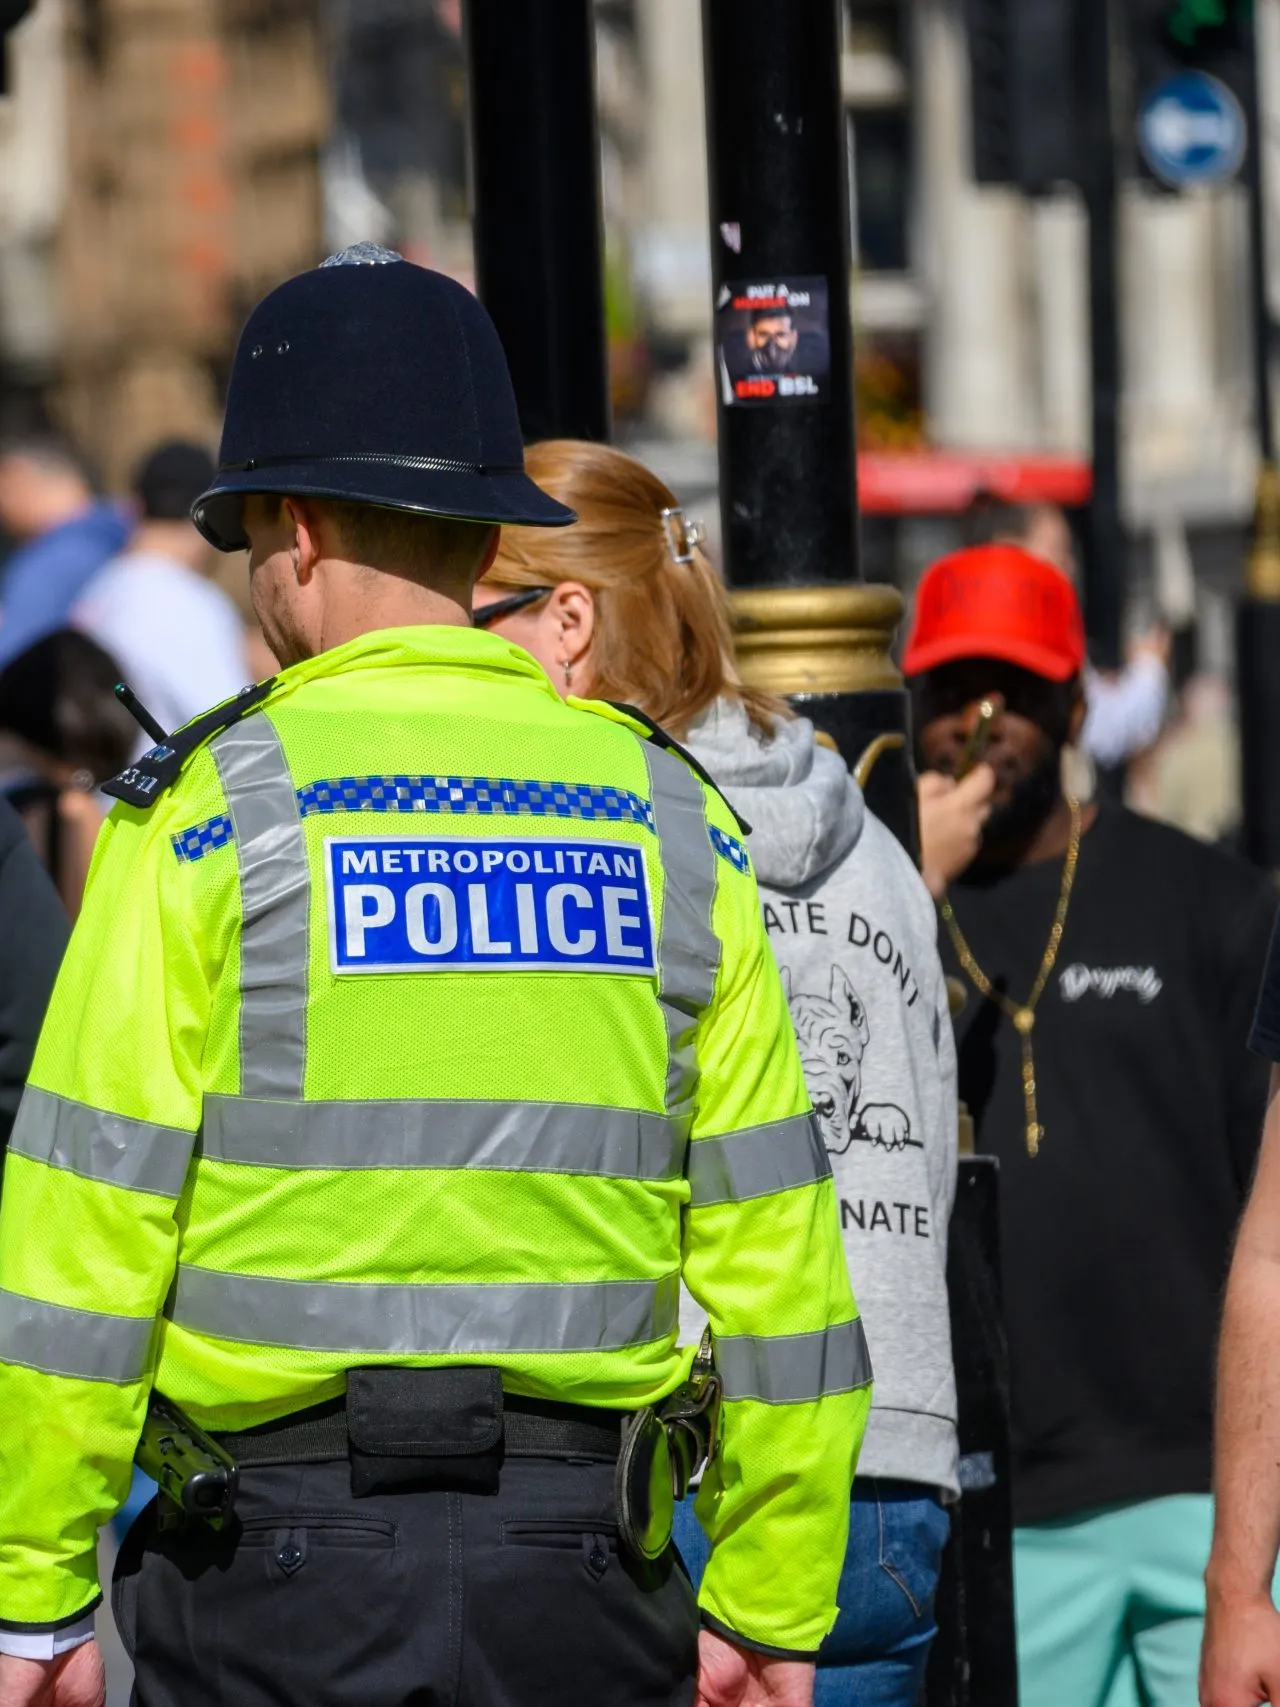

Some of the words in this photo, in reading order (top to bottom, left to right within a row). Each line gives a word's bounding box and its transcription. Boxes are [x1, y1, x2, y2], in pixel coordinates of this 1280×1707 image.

[342, 849, 637, 878] METROPOLITAN
[343, 882, 645, 959] POLICE
[841, 1198, 929, 1238] NATE
